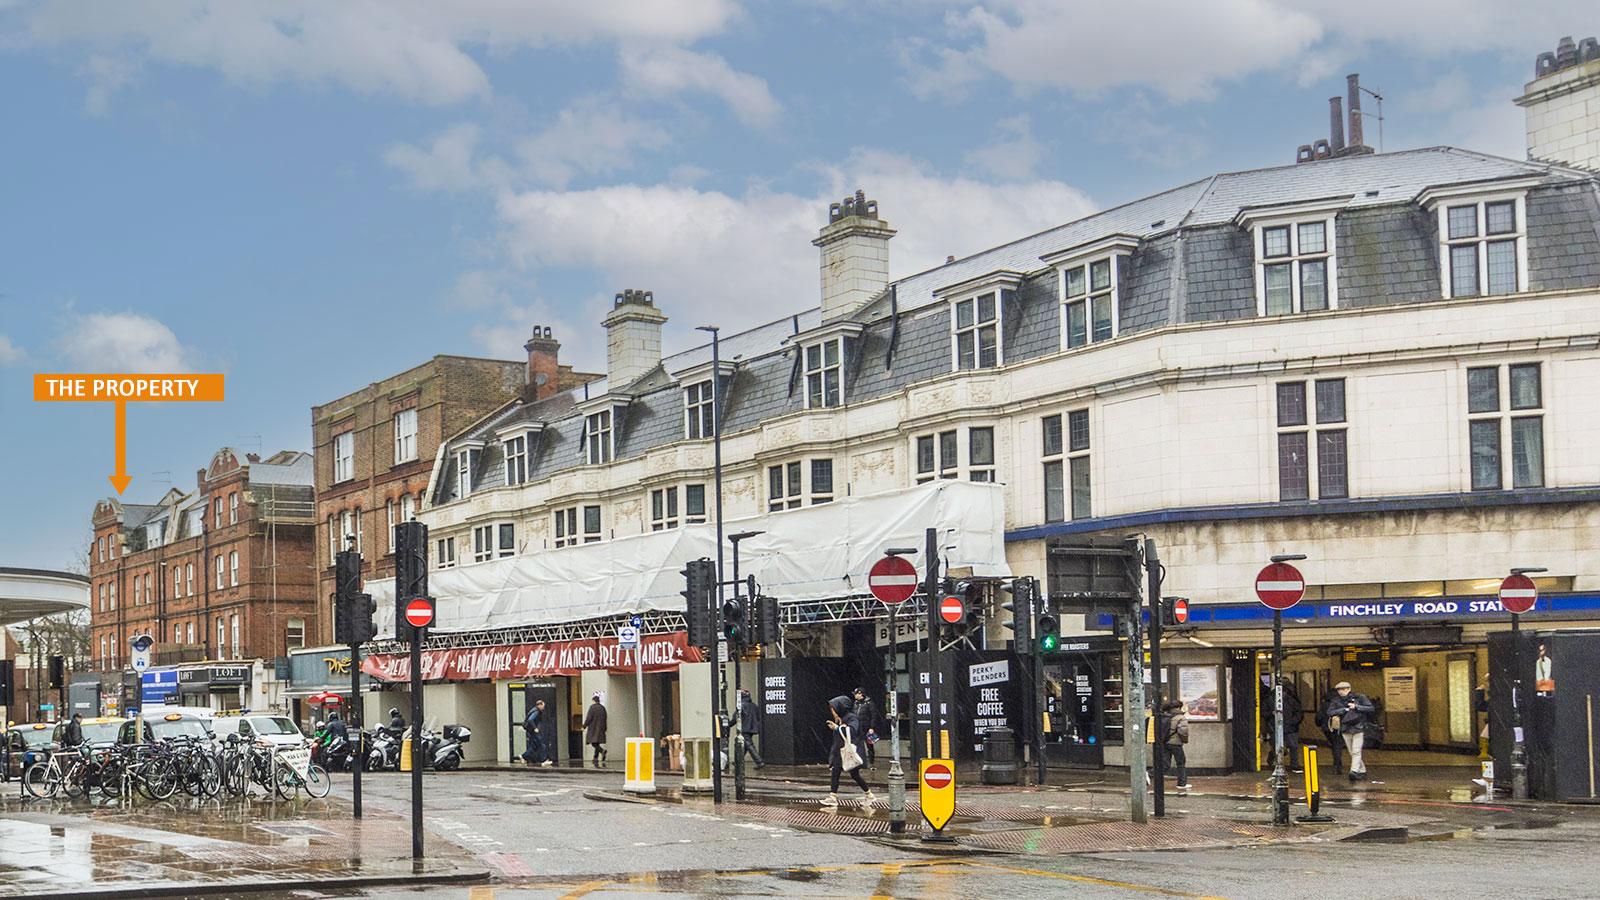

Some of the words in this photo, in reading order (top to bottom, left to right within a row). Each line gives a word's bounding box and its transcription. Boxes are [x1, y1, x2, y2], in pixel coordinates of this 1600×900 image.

[1330, 603, 1403, 616] FINCHLEY
[1414, 602, 1458, 614] ROAD
[1469, 600, 1535, 612] STAT
[559, 646, 597, 668] MANGER
[624, 648, 631, 666] A
[634, 641, 675, 665] ANGER
[180, 671, 193, 680] LOFT
[215, 668, 242, 677] LOFT
[972, 666, 994, 675] PERKY
[765, 676, 786, 687] COFFEE
[972, 671, 1007, 683] BLENDERS
[765, 690, 787, 701] COFFEE
[981, 688, 999, 702] FREE
[765, 703, 787, 714] COFFEE
[917, 703, 947, 715] STAN
[977, 702, 1004, 716] COFFEE
